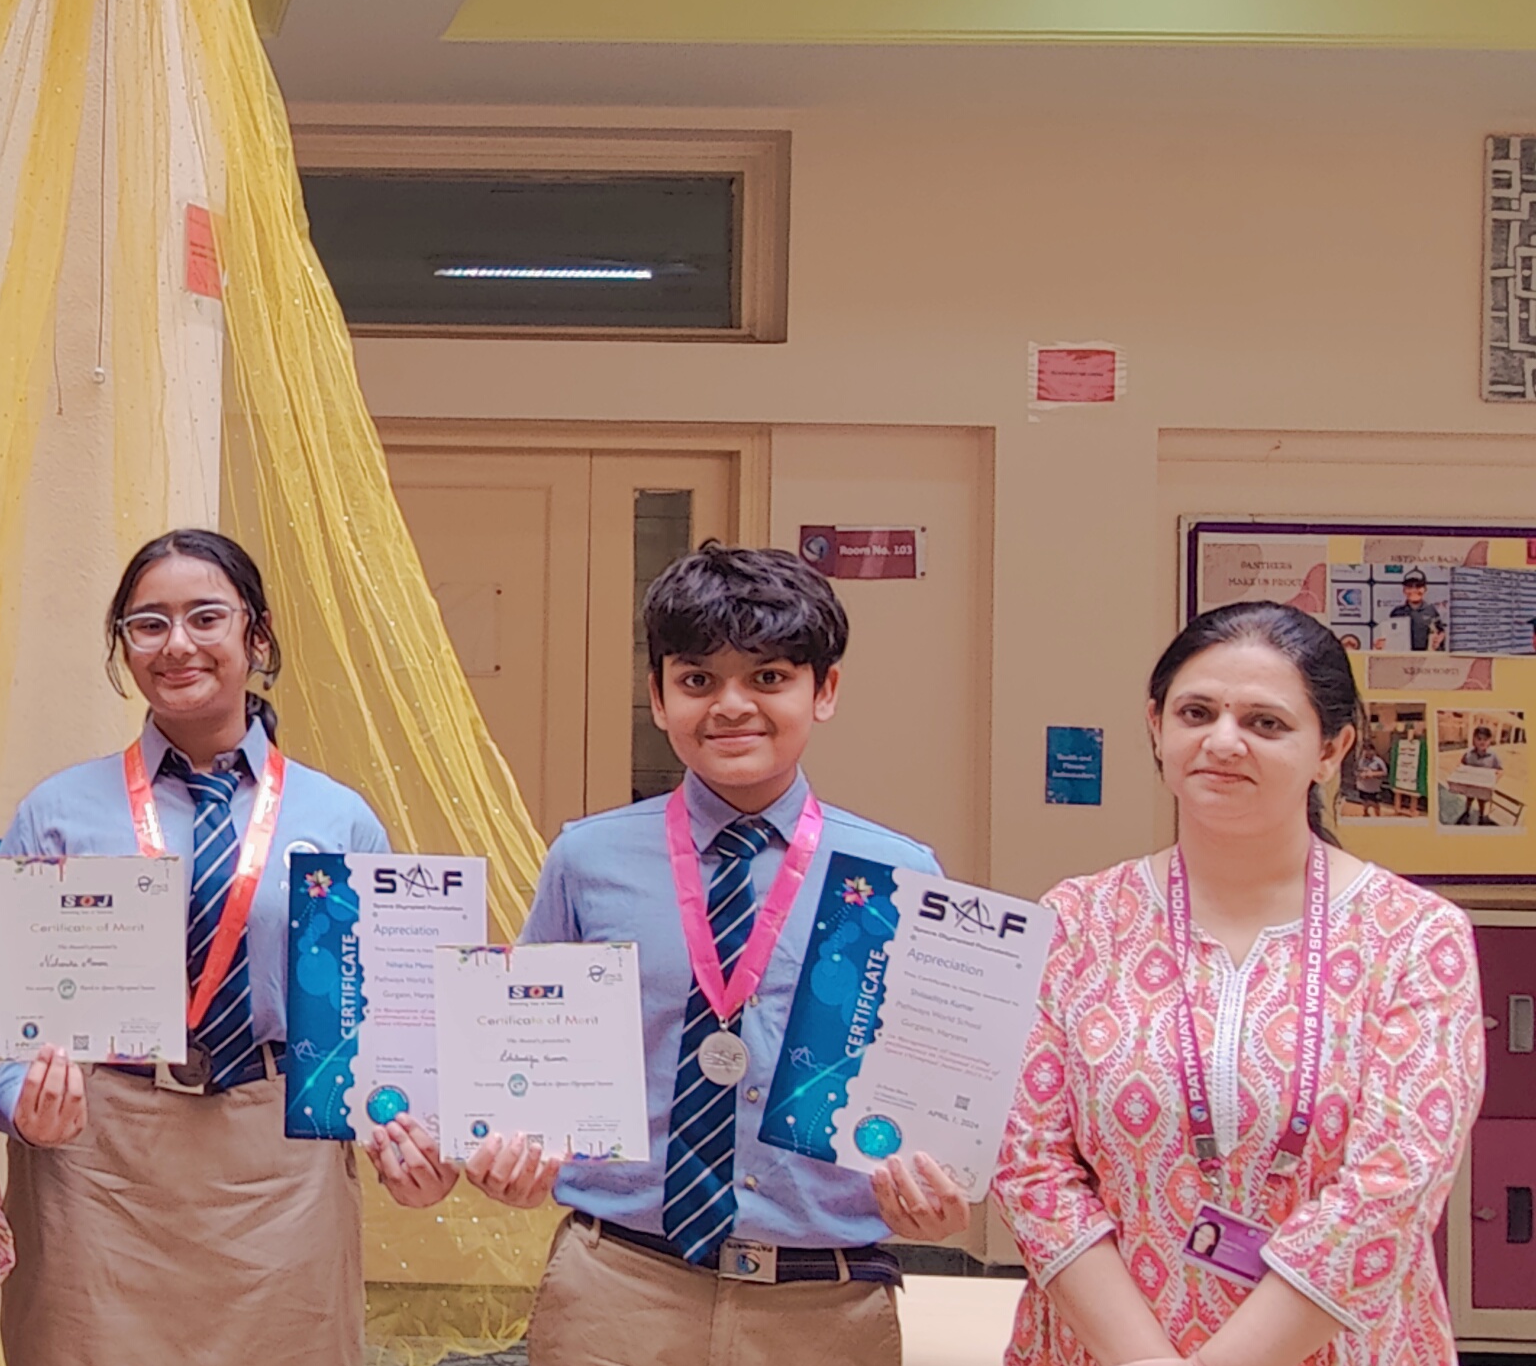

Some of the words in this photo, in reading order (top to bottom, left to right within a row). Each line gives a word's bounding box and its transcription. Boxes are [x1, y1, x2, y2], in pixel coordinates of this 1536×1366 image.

[839, 545, 871, 555] Room
[871, 545, 890, 555] No.
[893, 544, 913, 555] 103
[64, 895, 110, 908] SOJ
[1172, 878, 1186, 941] SCHOOL
[30, 922, 92, 932] Certificate
[96, 922, 109, 932] of
[113, 923, 144, 932] Merit
[1308, 884, 1325, 950] SCHOOL
[374, 924, 439, 936] Appreciation
[907, 947, 984, 977] Appreciation
[340, 934, 357, 1040] CERTIFICATE
[511, 985, 561, 999] SOJ
[1305, 952, 1321, 1013] WORLD
[845, 949, 886, 1059] CERTIFICATE
[476, 1015, 544, 1026] Certificate
[547, 1015, 561, 1025] of
[565, 1015, 599, 1025] Merit
[1296, 1016, 1318, 1115] PATHWAYS
[927, 1110, 949, 1123] APRIL
